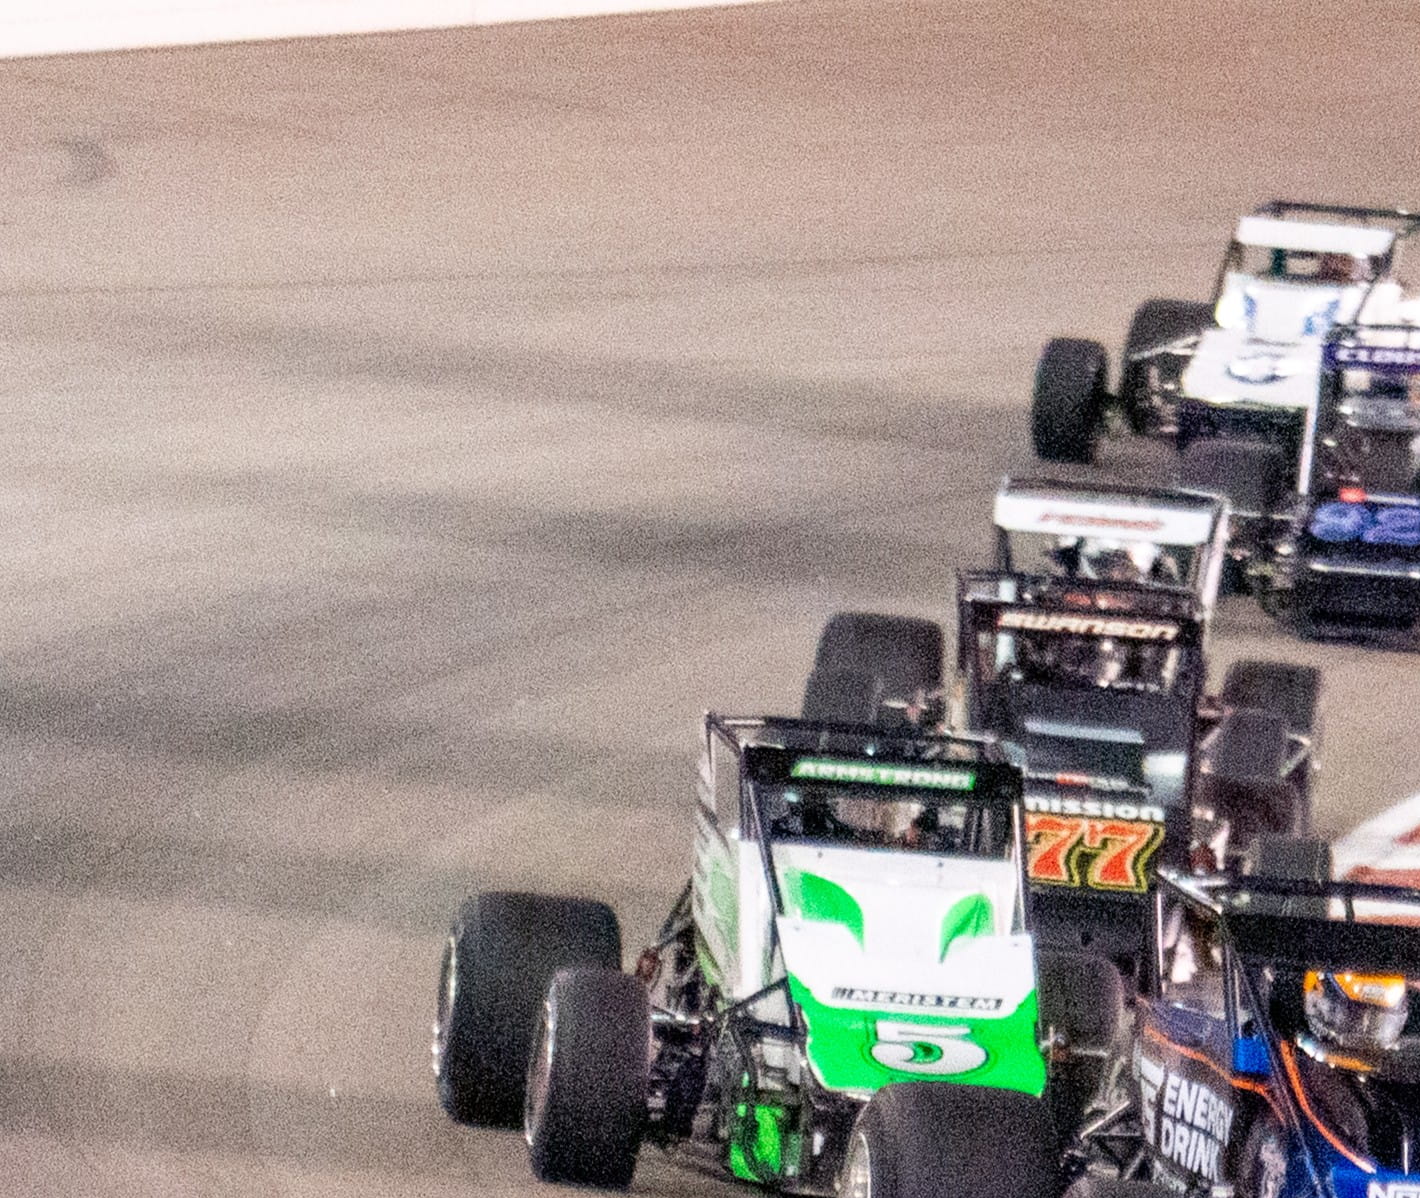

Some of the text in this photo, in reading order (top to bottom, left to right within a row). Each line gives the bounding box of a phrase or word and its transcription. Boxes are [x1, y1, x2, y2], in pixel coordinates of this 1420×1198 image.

[1025, 813, 1163, 893] 77
[869, 1017, 989, 1076] 5
[1163, 1070, 1235, 1148] ENERGY
[1160, 1114, 1222, 1183] DRINK
